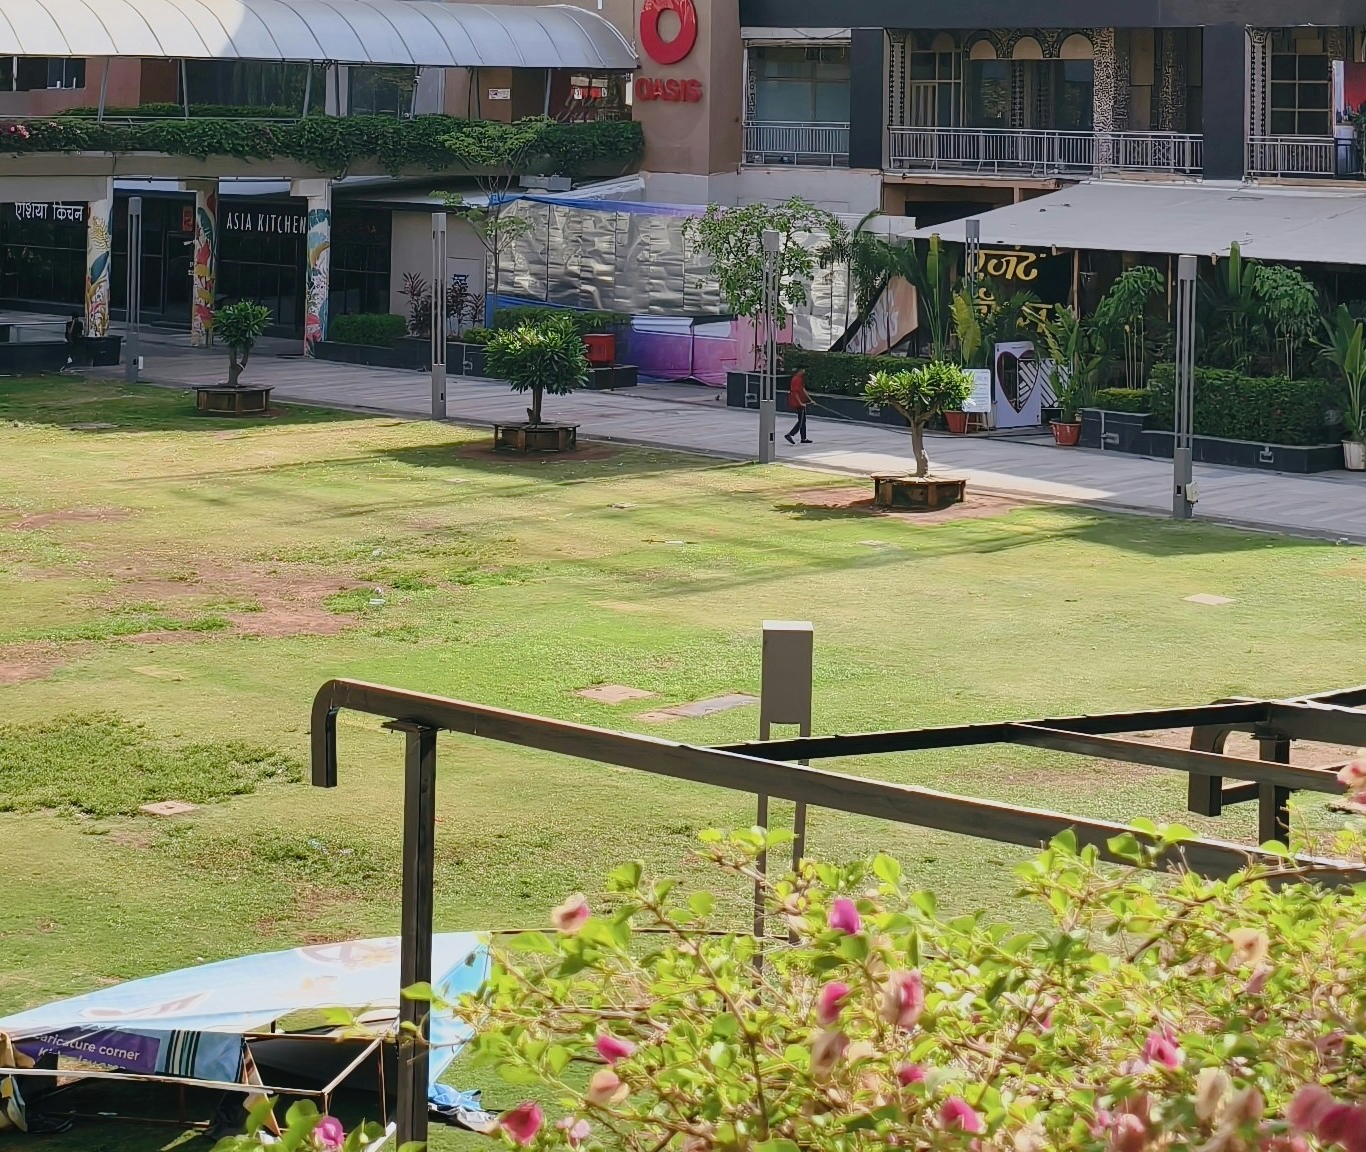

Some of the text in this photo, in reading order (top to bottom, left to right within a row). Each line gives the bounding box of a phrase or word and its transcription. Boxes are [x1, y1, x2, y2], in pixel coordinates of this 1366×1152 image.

[635, 77, 703, 103] OASIS
[52, 201, 84, 222] किचन
[226, 212, 307, 235] ASIA KITCHEN
[99, 1045, 141, 1061] corner
